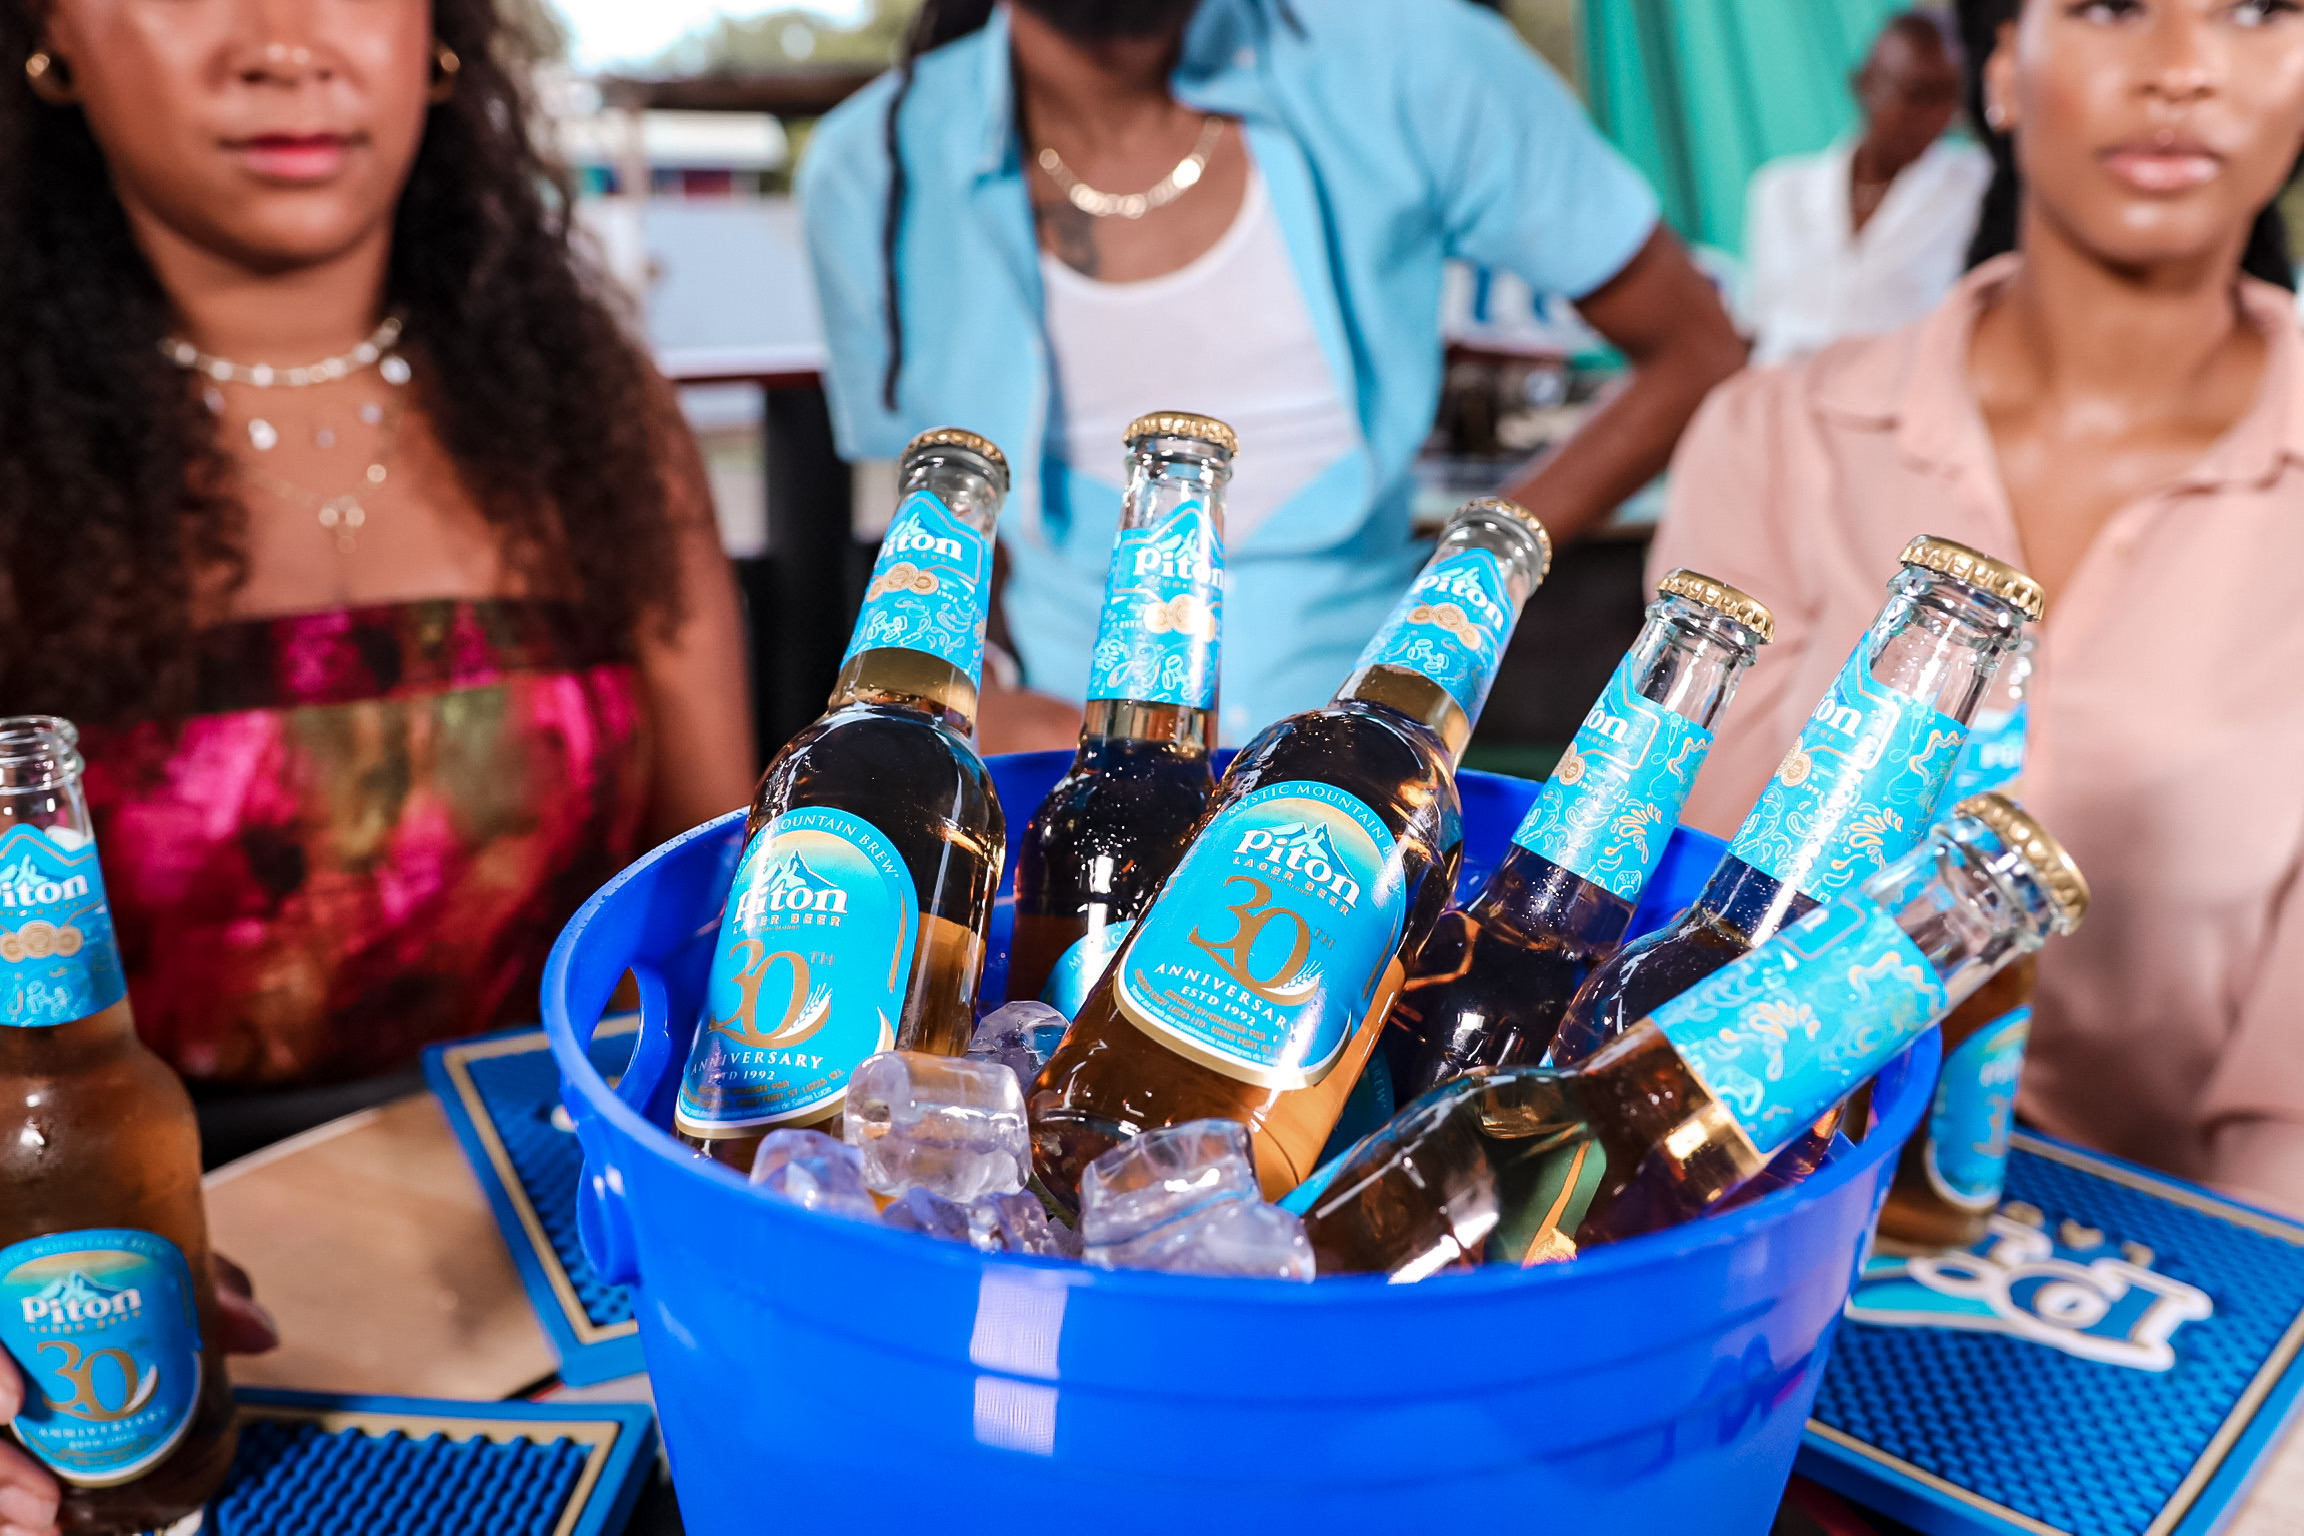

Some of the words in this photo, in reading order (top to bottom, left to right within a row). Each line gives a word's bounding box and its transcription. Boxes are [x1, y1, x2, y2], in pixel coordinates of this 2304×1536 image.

[881, 531, 963, 561] iton
[1133, 547, 1224, 590] Piton
[1411, 574, 1504, 631] Piton
[1227, 784, 1290, 816] MYSTIC
[1296, 784, 1386, 839] MOUNTAIN
[0, 873, 89, 907] iton
[1233, 829, 1360, 908] Piton
[732, 914, 780, 935] LAER
[790, 913, 841, 927] BEER
[1188, 875, 1316, 1005] 30
[708, 938, 822, 1049] 30
[1153, 962, 1297, 1037] ANNIVERSARY
[1181, 986, 1220, 1005] ESTD
[1223, 1002, 1256, 1027] 1992
[690, 1051, 823, 1076] ANNIVERSARY
[743, 1070, 776, 1081] 1992
[21, 1288, 142, 1324] Piton
[37, 1340, 150, 1422] 30
